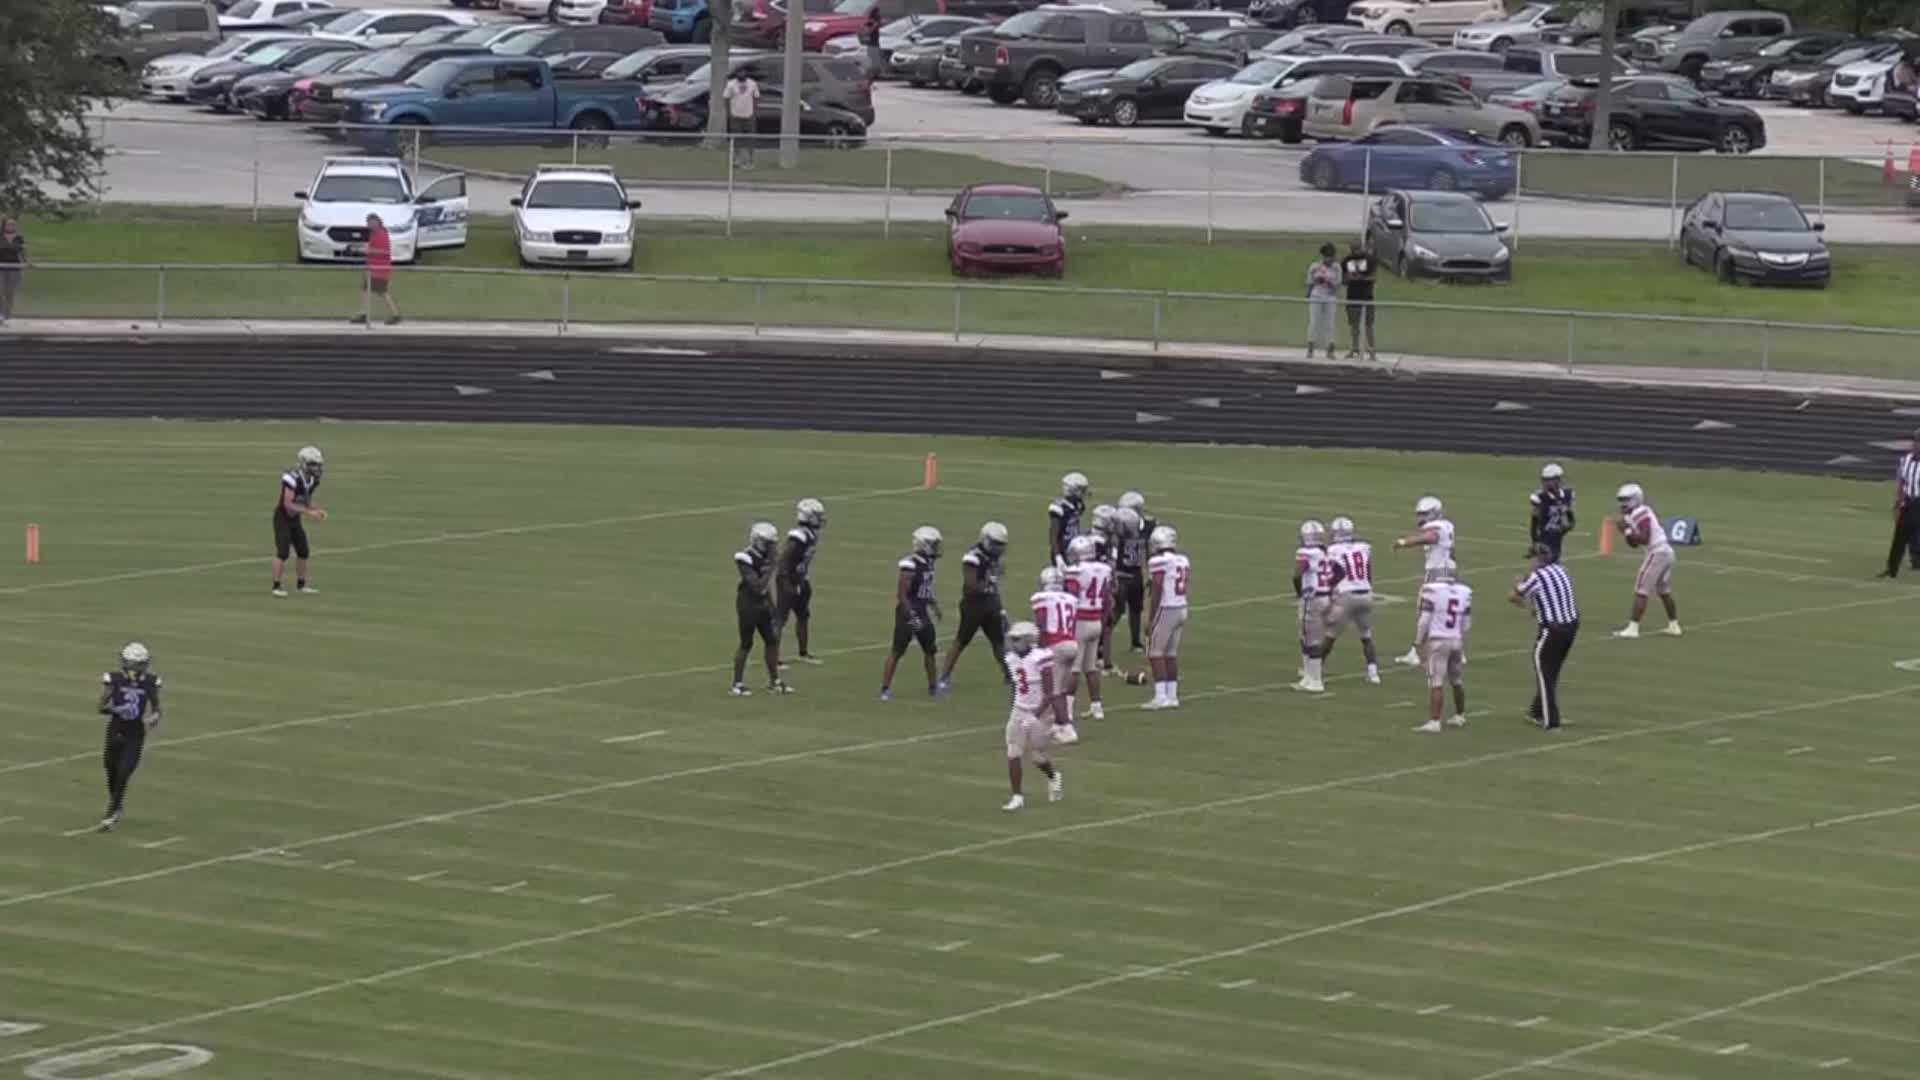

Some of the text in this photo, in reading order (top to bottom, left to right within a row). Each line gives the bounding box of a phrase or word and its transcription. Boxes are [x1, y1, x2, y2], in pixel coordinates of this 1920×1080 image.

[1671, 519, 1688, 541] G
[1343, 550, 1366, 581] 18
[1056, 602, 1074, 635] 12
[1446, 598, 1461, 629] 5
[1015, 668, 1029, 695] 3
